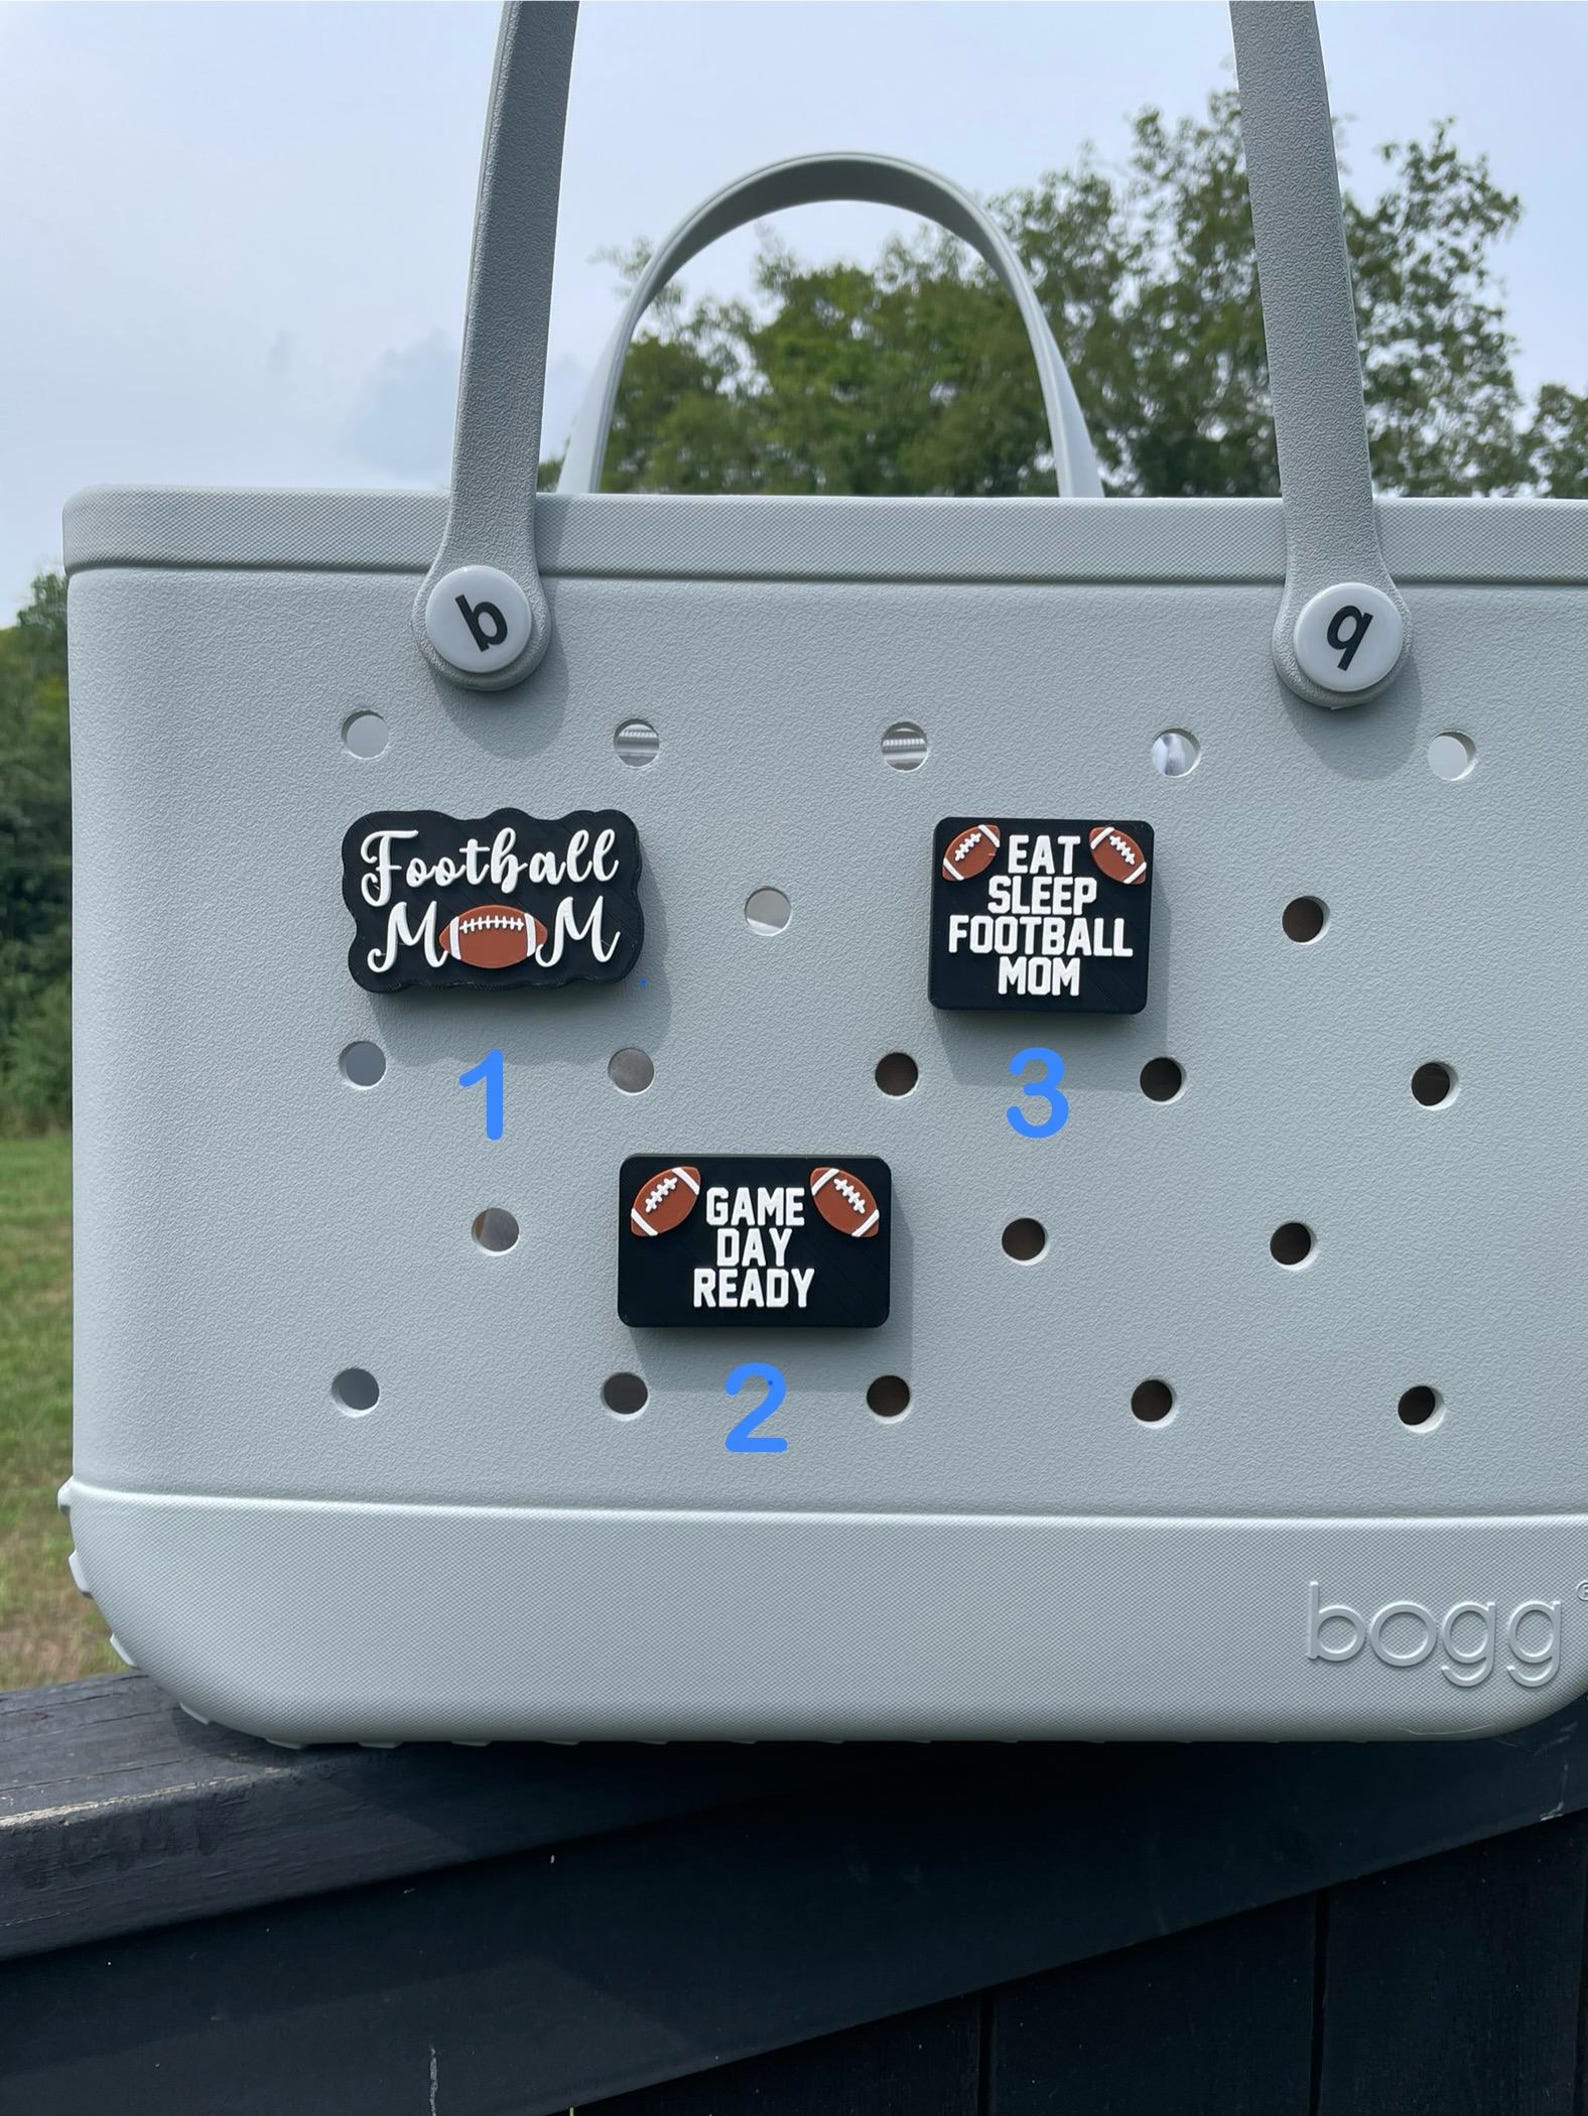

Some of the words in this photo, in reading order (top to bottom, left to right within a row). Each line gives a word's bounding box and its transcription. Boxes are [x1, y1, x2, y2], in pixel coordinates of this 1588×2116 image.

[454, 593, 509, 653] b
[360, 826, 619, 907] Football
[1007, 834, 1081, 875] EAT
[987, 875, 1098, 916] SLEEP
[948, 914, 1134, 958] FOOTBALL
[997, 956, 1081, 997] MOM
[706, 1186, 806, 1226] GAME
[716, 1227, 793, 1267] DAY
[693, 1267, 815, 1308] READY
